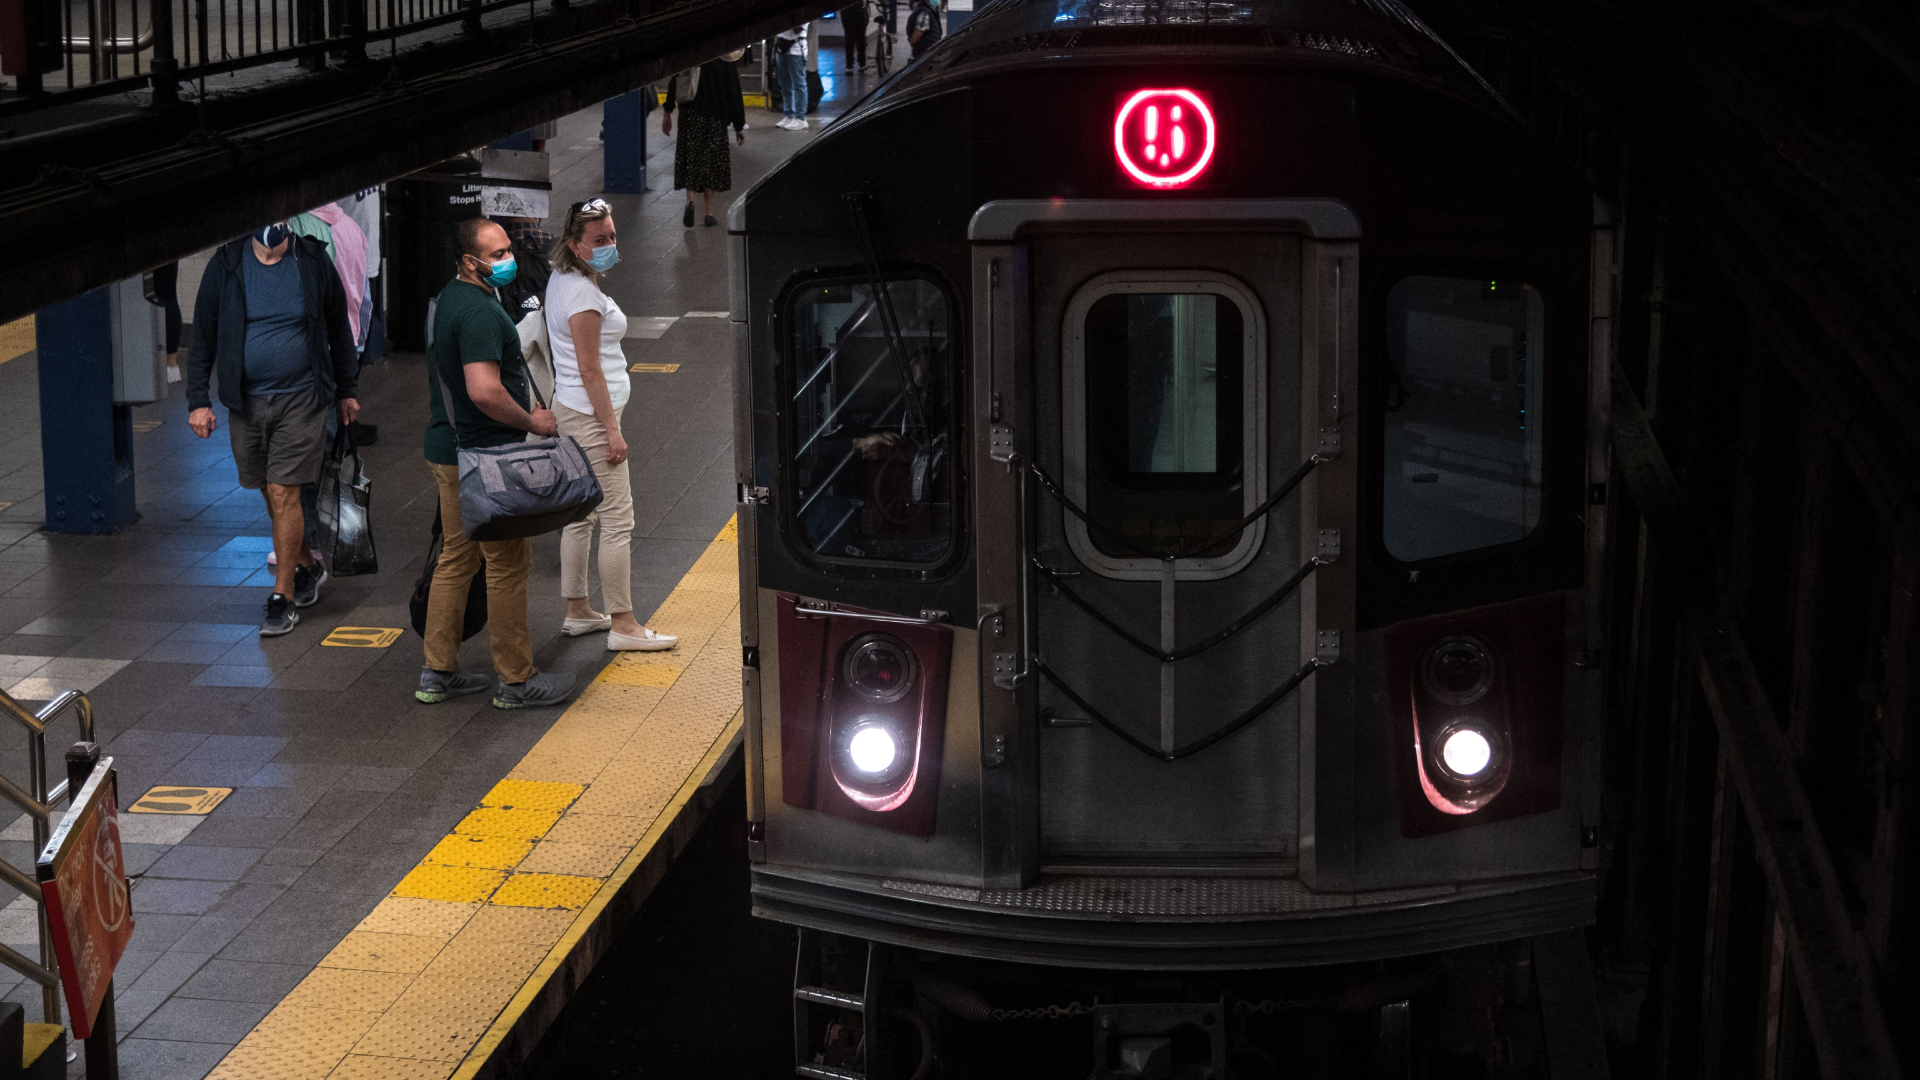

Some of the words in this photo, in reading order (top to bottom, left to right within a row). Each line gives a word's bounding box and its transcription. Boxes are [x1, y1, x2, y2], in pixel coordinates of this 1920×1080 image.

[449, 195, 475, 205] Stops
[71, 842, 85, 879] not
[65, 881, 83, 929] enter
